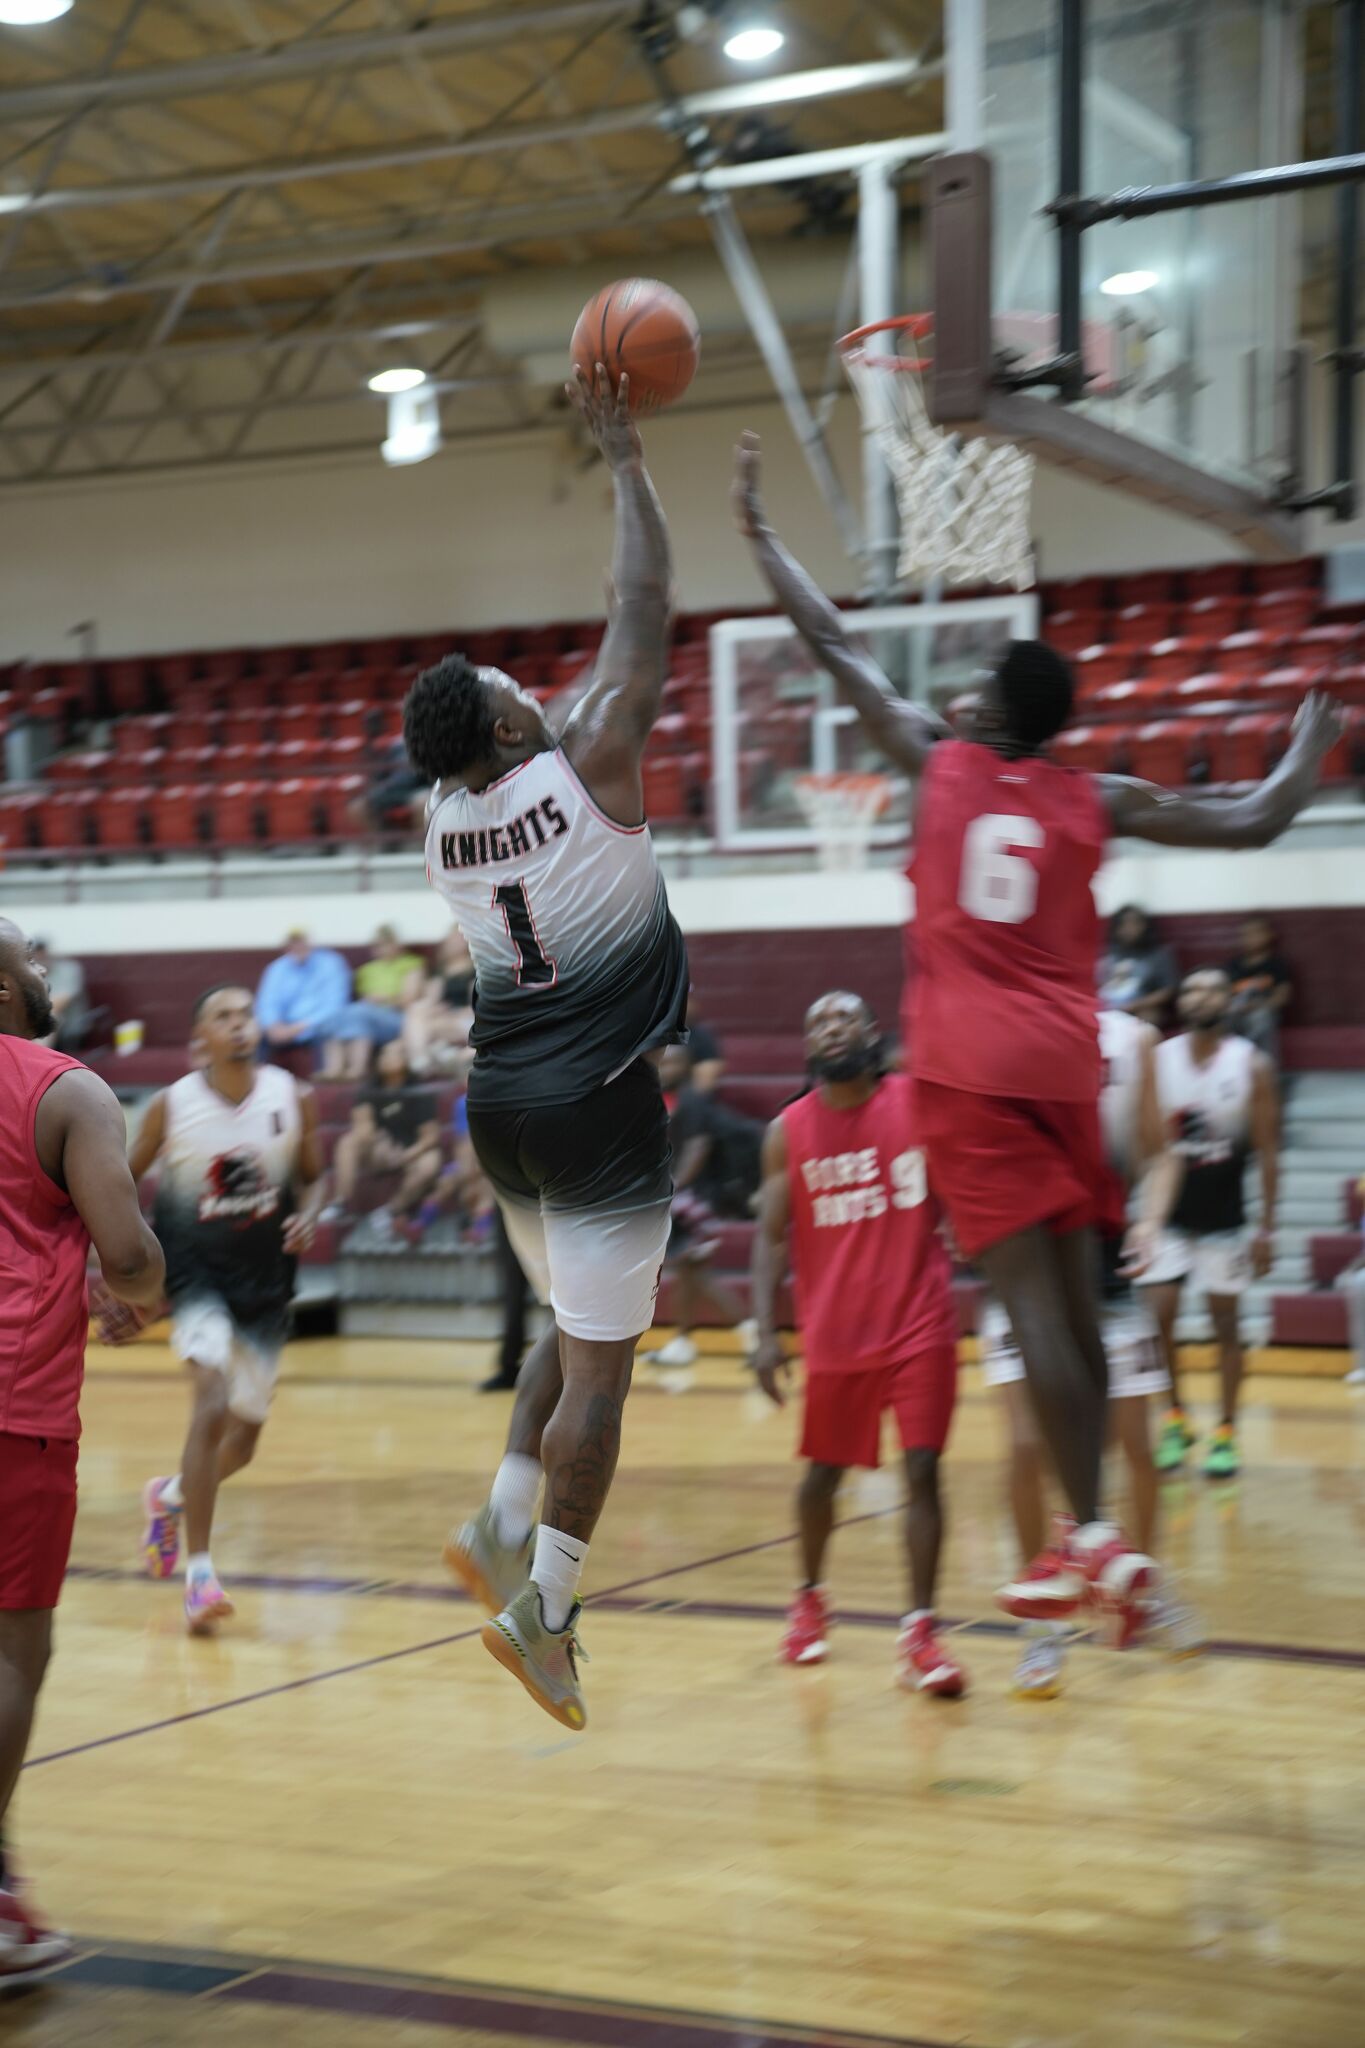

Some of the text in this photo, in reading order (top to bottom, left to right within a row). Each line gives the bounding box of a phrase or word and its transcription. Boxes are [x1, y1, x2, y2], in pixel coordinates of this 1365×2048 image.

[440, 796, 570, 870] KNIGHTS
[956, 813, 1047, 925] 6
[491, 876, 558, 989] 1
[890, 1148, 929, 1210] 9
